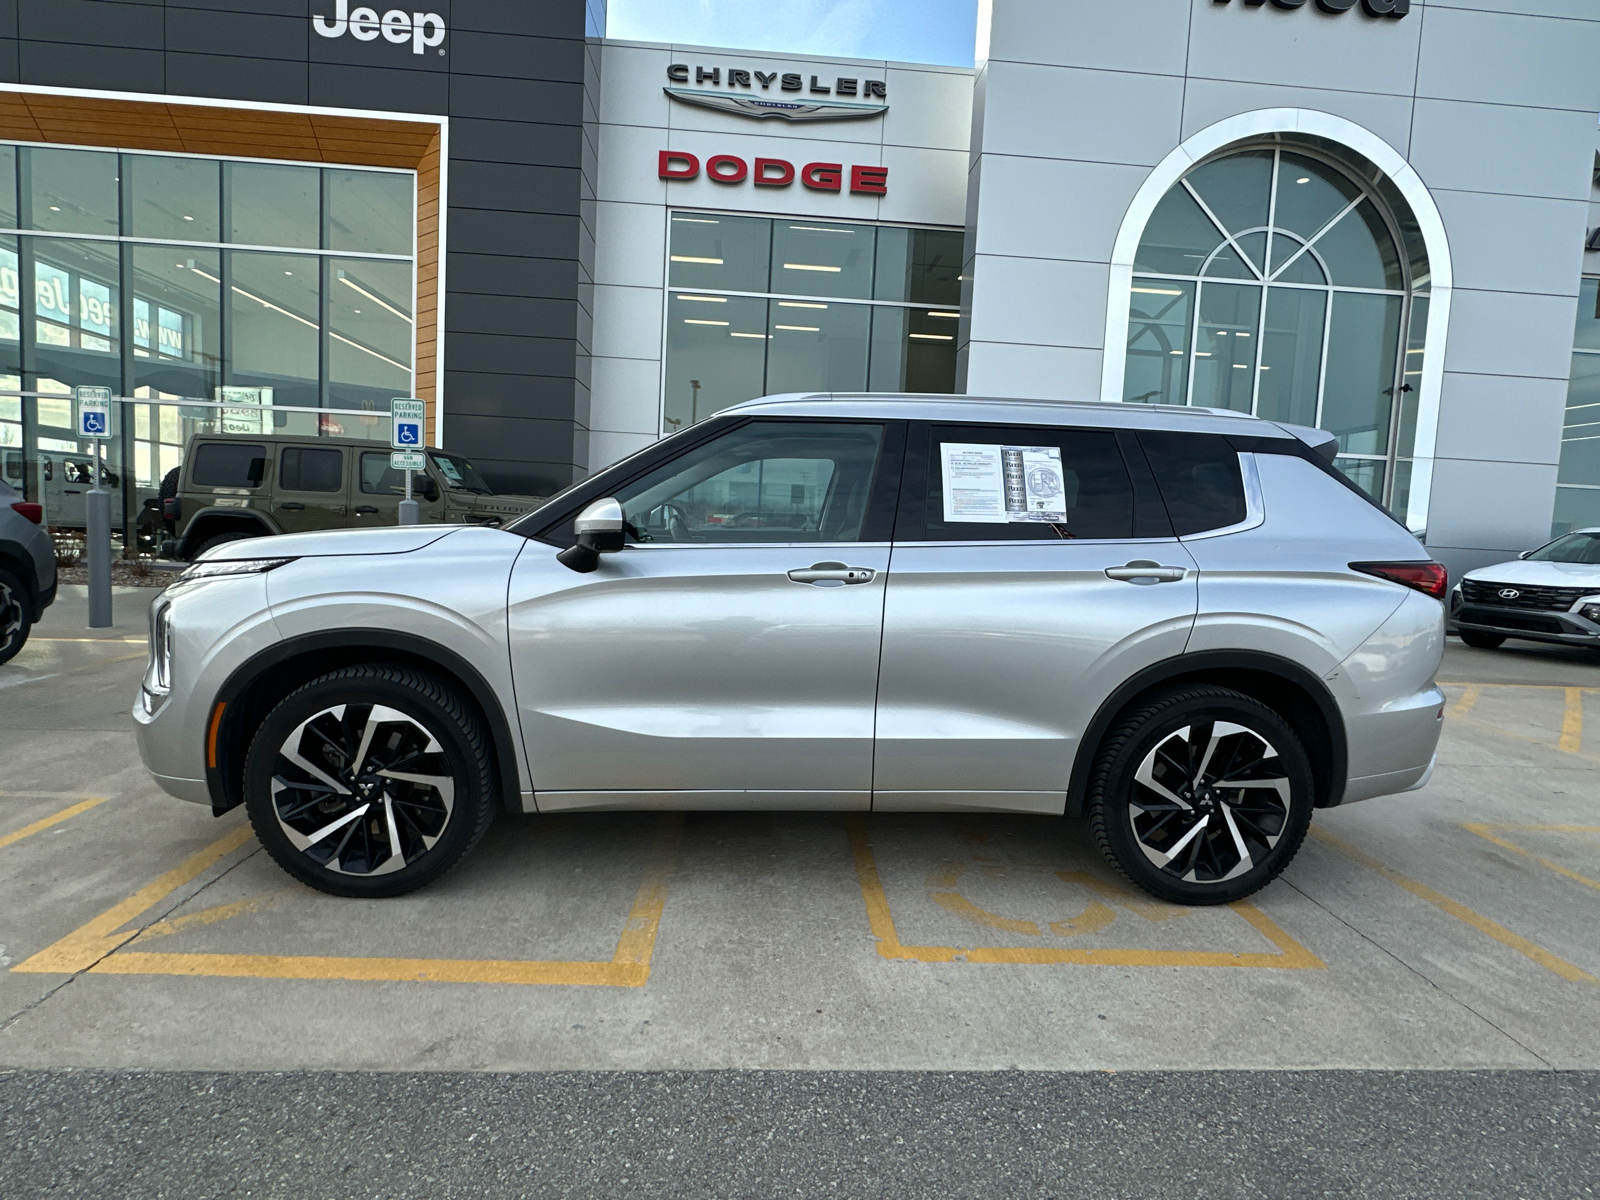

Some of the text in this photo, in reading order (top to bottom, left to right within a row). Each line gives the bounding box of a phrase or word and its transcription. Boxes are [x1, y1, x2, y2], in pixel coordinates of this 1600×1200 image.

[312, 0, 446, 55] Jeep
[667, 64, 887, 96] CHRYSLER
[754, 101, 798, 109] CHRYSLER
[658, 150, 889, 196] DODGE
[79, 391, 108, 399] RESERVED
[79, 400, 109, 408] PARKING
[394, 402, 422, 411] RESERVED
[394, 411, 423, 420] PARKING
[484, 504, 529, 513] RUBI
